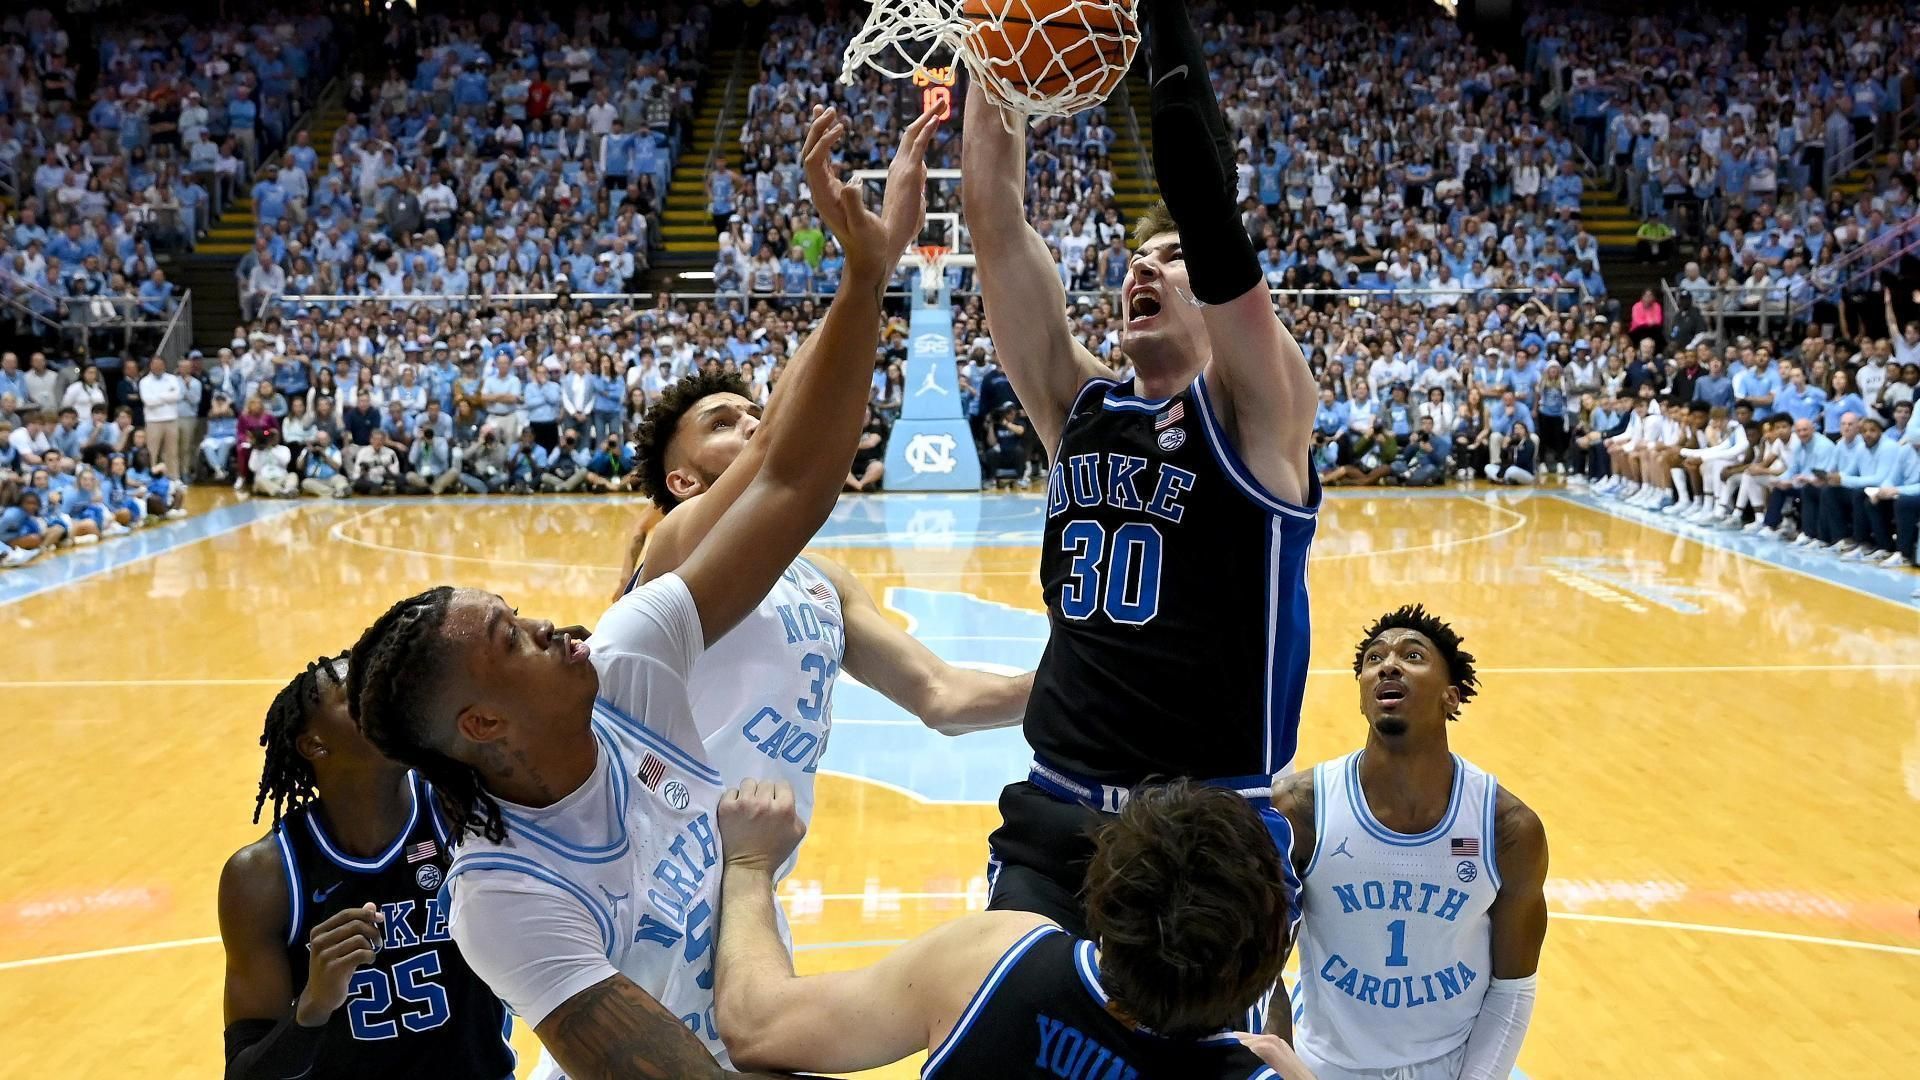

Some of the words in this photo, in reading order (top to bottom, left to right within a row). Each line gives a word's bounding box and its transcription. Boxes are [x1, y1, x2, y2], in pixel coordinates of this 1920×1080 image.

[1049, 452, 1197, 524] DUKE
[1061, 519, 1163, 626] 30
[634, 812, 718, 949] NORTH
[1332, 880, 1470, 922] NORTH
[368, 899, 453, 953] KE
[1385, 919, 1409, 967] 1
[347, 949, 451, 1041] 25
[1320, 954, 1477, 1009] CAROLINA
